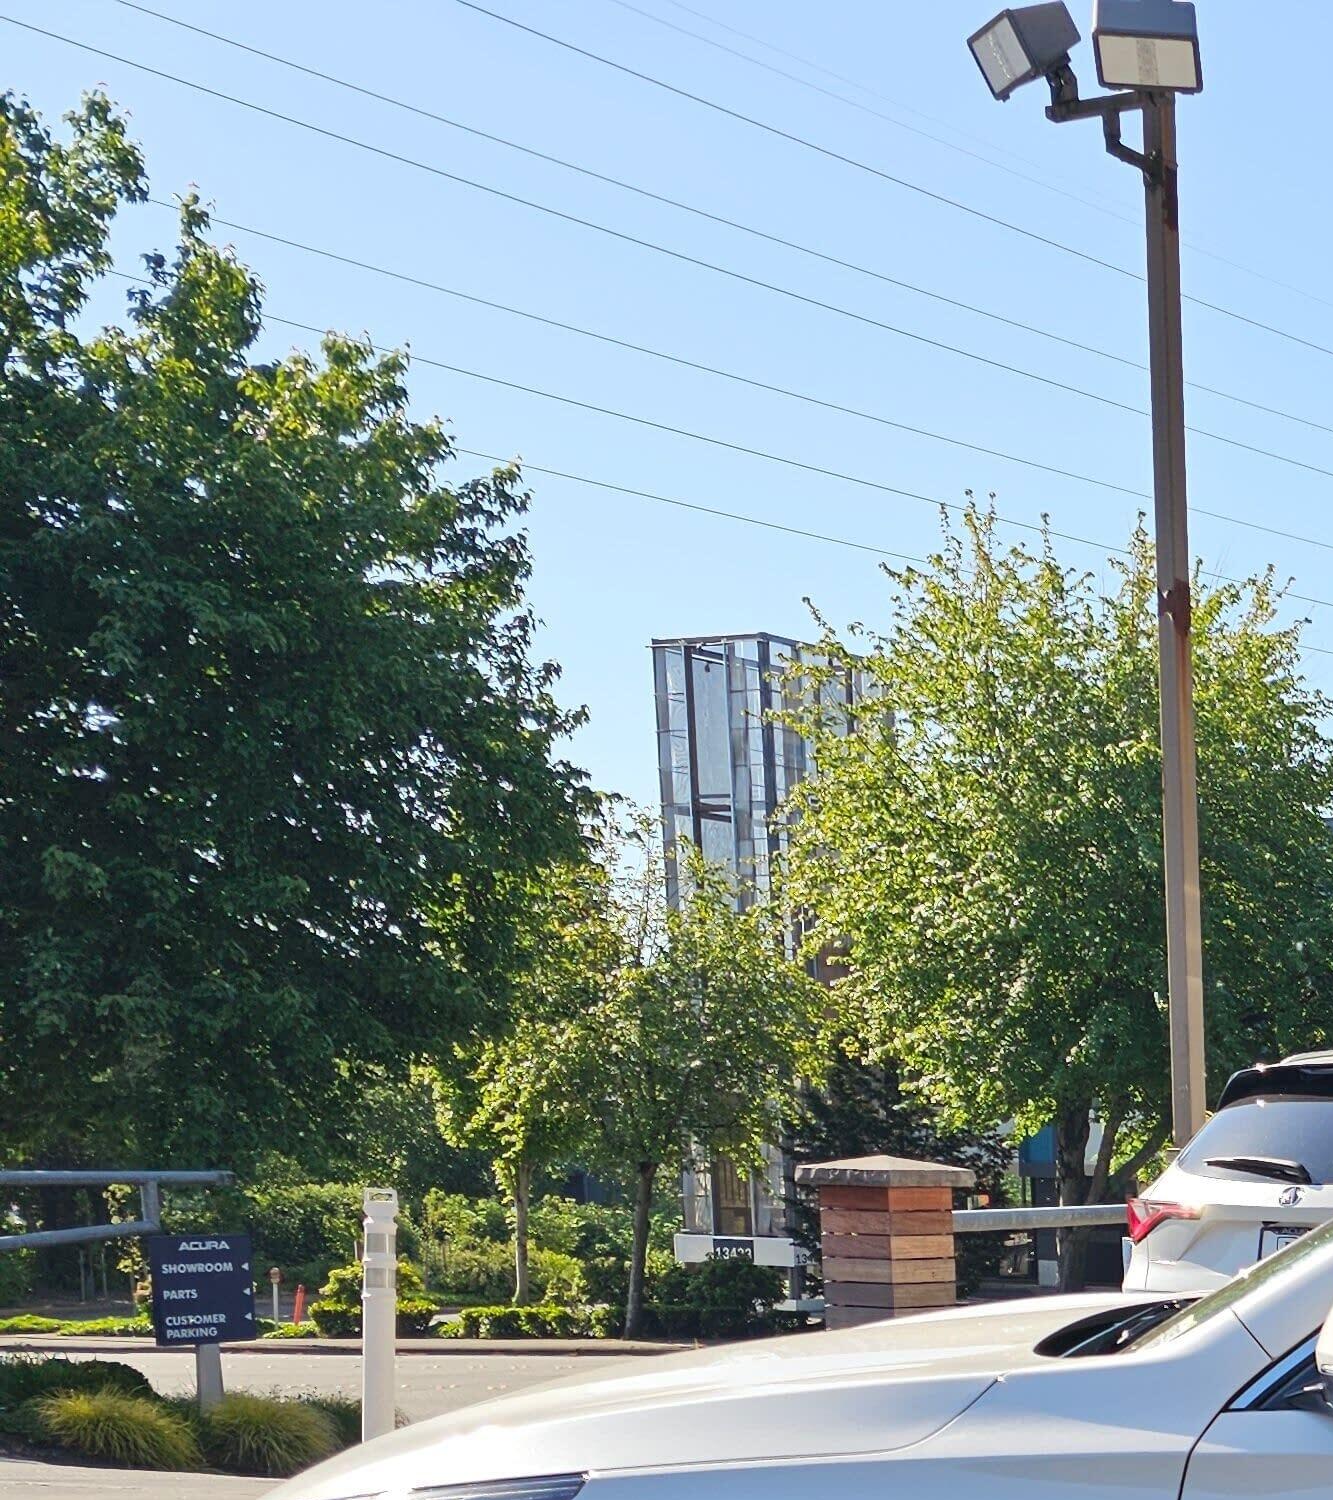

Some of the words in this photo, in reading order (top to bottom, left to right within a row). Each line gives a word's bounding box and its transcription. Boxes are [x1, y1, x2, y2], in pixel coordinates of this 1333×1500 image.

[178, 1240, 230, 1251] ACURA
[161, 1262, 233, 1274] SHOWROOM
[163, 1289, 198, 1300] PARTS
[165, 1314, 226, 1326] CUSTOMER
[166, 1327, 218, 1339] PARKING
